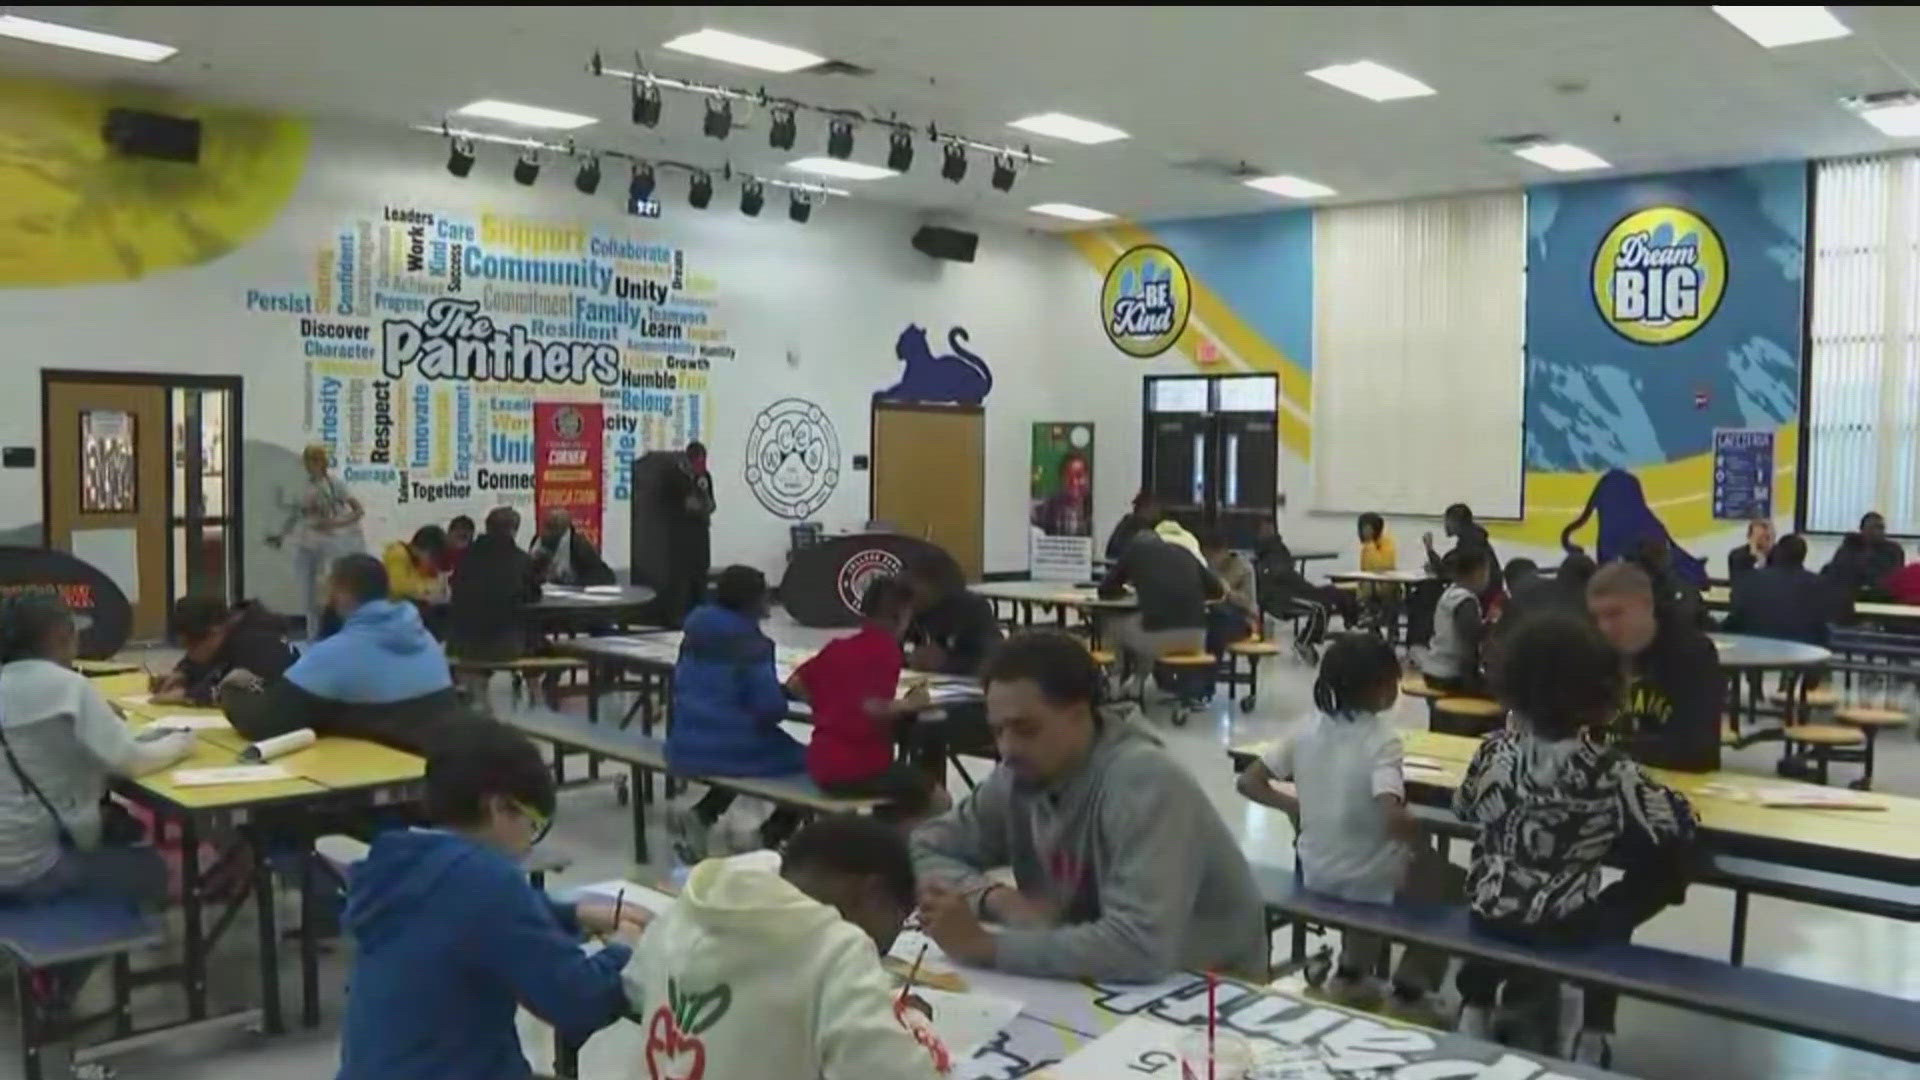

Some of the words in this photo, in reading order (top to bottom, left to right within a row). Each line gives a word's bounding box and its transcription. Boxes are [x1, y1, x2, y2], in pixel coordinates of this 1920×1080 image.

[385, 206, 434, 226] Leaders
[438, 219, 475, 241] Care
[480, 211, 587, 257] Support
[408, 227, 424, 271] Work
[429, 241, 447, 276] Kind
[590, 235, 671, 263] Collaborate
[1615, 232, 1697, 268] Dream
[338, 235, 354, 315] Confident
[447, 244, 462, 293] Success
[464, 246, 613, 295] Community
[246, 289, 311, 314] Persist
[484, 284, 573, 318] Commitment
[615, 276, 668, 305] Unity
[1145, 283, 1170, 308] BE
[1615, 267, 1698, 321] BIG
[422, 298, 494, 338] The
[576, 296, 641, 331] Family
[641, 317, 682, 338] Learn
[1111, 299, 1173, 336] Kind
[300, 319, 370, 341] Discover
[531, 318, 618, 341] Resilient
[304, 342, 374, 360] Character
[382, 319, 620, 385] Panthers
[666, 355, 710, 370] Growth
[621, 369, 677, 390] Humble
[491, 396, 531, 410] Excell
[621, 389, 673, 417] Belong
[370, 380, 394, 464] Respect
[411, 383, 429, 468] Innovate
[602, 416, 637, 434] city
[344, 464, 396, 484] Courage
[478, 468, 535, 490] Connec
[614, 434, 636, 499] Pride
[411, 481, 471, 504] Together
